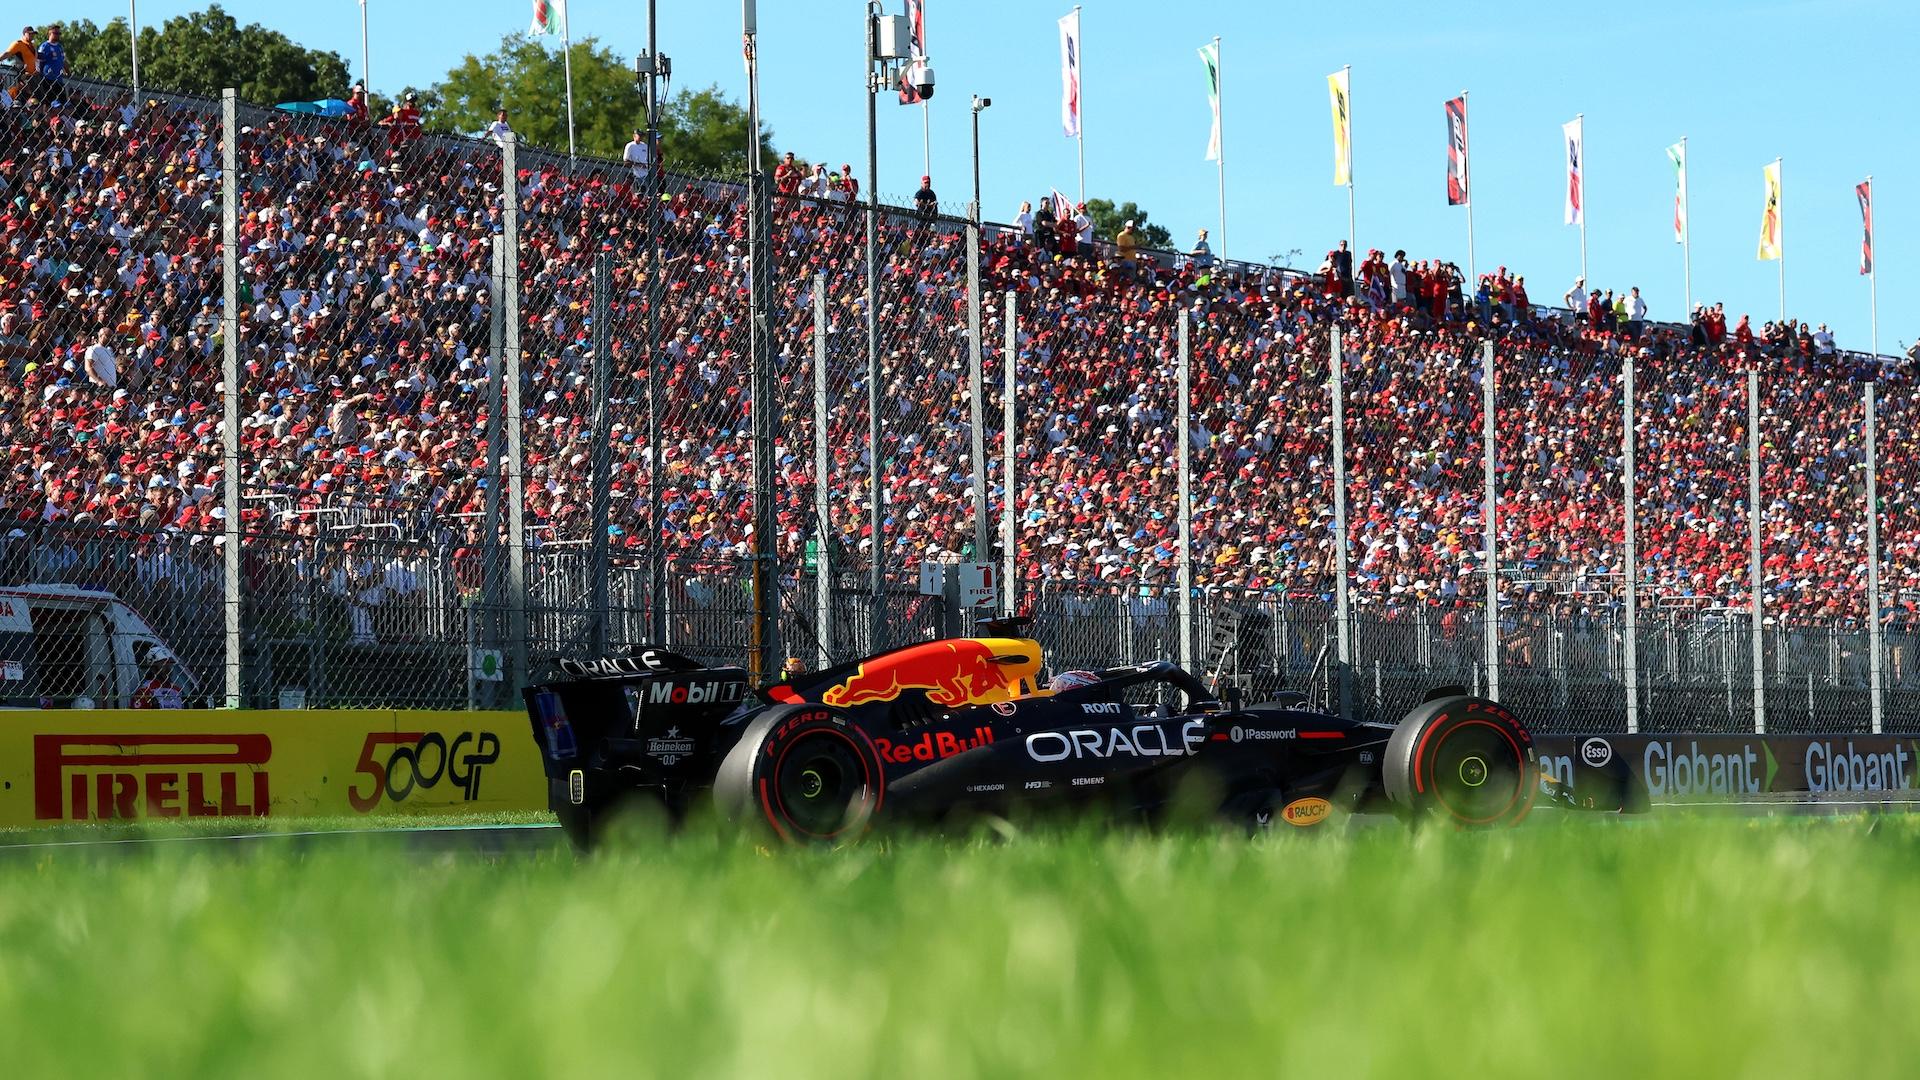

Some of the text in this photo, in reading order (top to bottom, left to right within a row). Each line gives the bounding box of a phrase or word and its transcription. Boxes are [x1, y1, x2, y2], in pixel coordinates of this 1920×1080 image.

[559, 650, 669, 678] ORACLE
[649, 681, 719, 705] Mobil
[1081, 702, 1121, 714] ROKT
[767, 710, 830, 758] P ZERO
[1244, 728, 1296, 740] 1Password
[1465, 702, 1531, 744] P ZERO
[650, 741, 692, 752] Heineken
[1026, 721, 1205, 762] ORACLE
[1586, 744, 1608, 759] Esso
[34, 733, 272, 820] PIRELLI
[1644, 741, 1760, 796] Globant
[1805, 741, 1911, 795] Globant
[973, 783, 1005, 792] HEXAGON
[1071, 776, 1105, 786] SIEMENS
[1295, 804, 1326, 818] RAUCH
